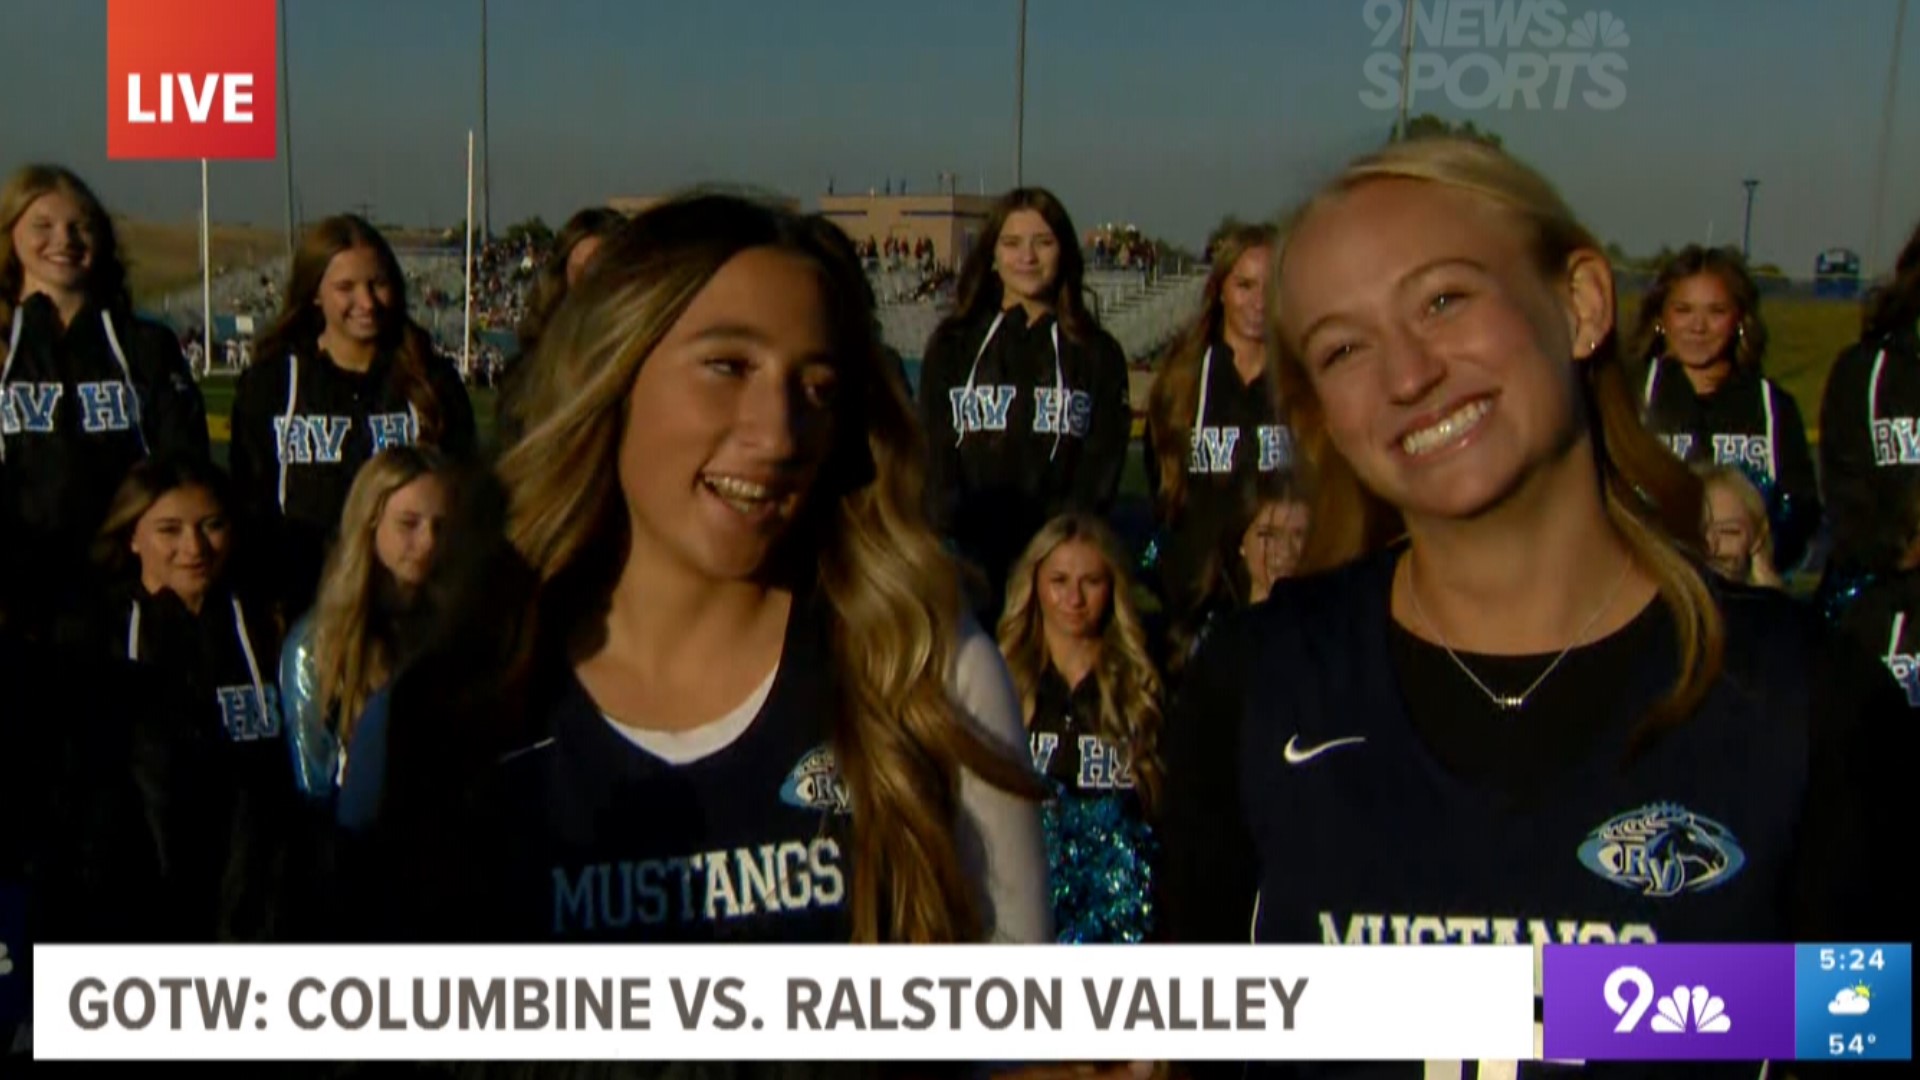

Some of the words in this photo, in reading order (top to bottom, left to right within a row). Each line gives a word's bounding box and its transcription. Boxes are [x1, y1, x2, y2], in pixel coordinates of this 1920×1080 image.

[77, 380, 142, 433] H
[949, 384, 1017, 433] RV
[1033, 386, 1093, 437] HS
[367, 411, 420, 456] H
[551, 837, 846, 934] MUSTANGS
